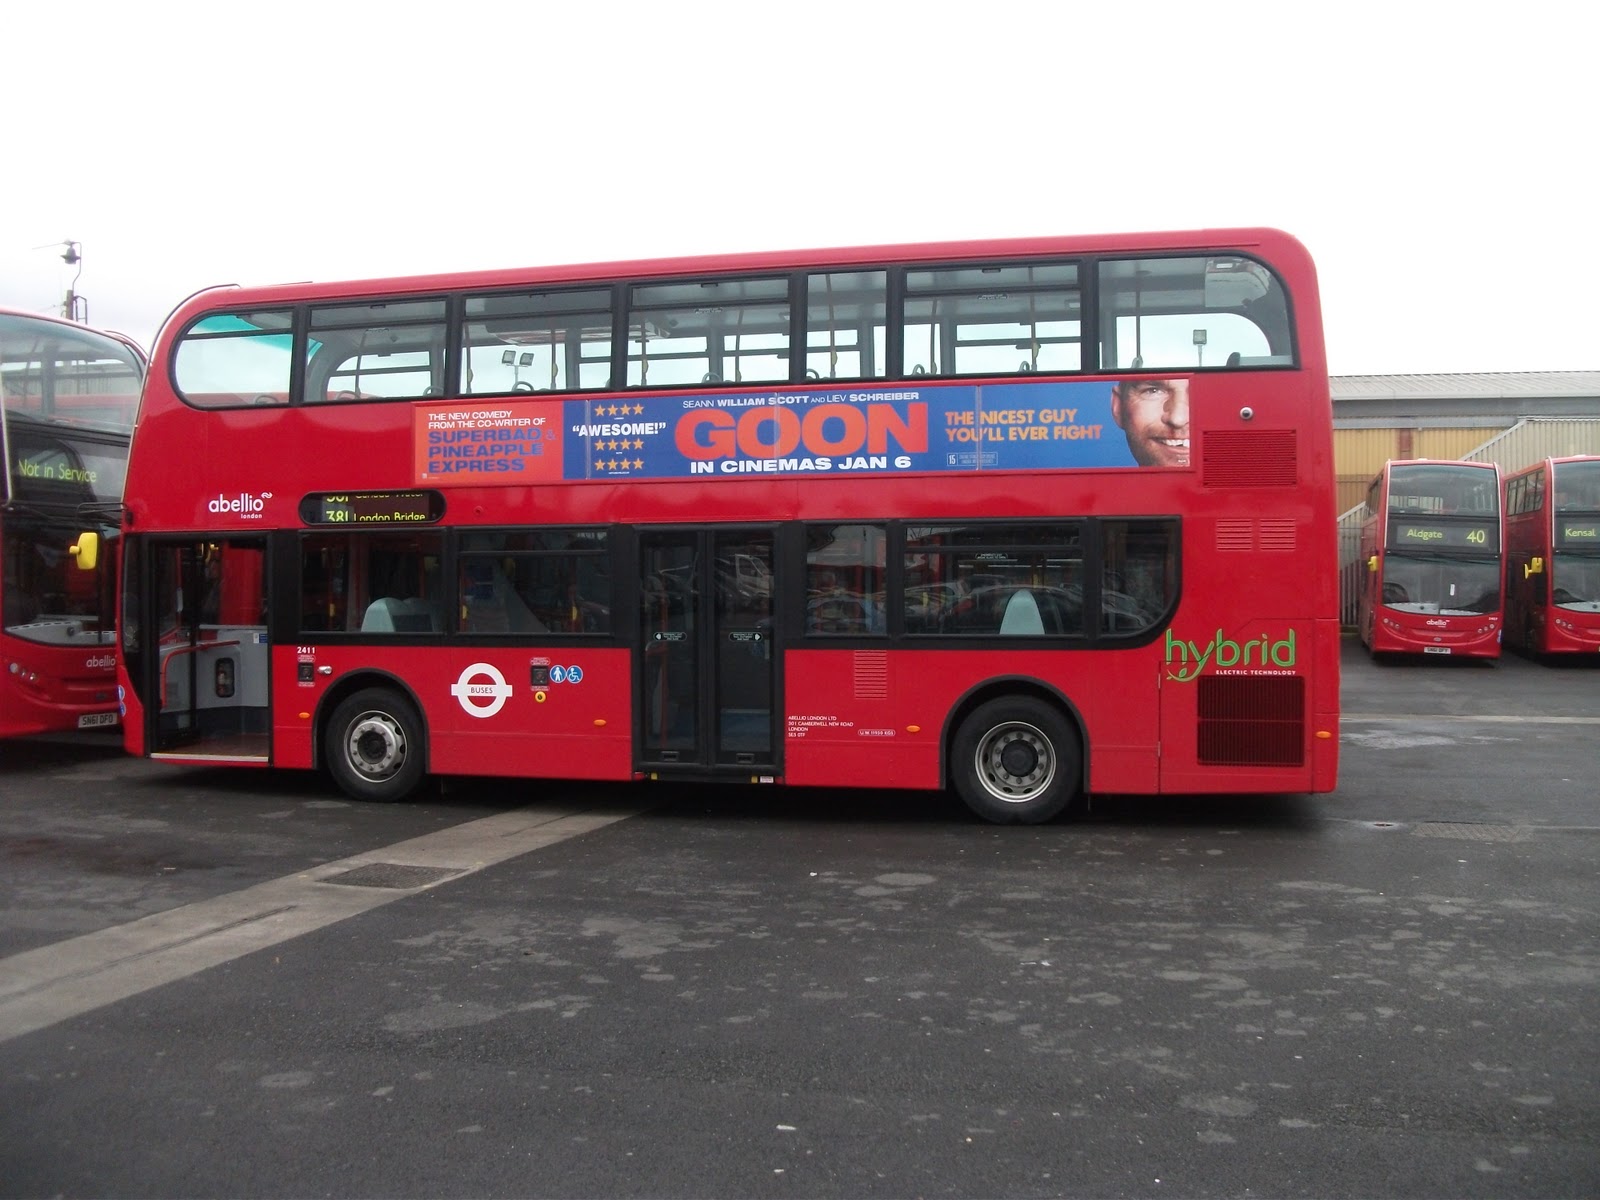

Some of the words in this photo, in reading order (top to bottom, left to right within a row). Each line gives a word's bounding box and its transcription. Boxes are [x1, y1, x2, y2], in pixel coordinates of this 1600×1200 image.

[682, 400, 715, 408] SEANN
[717, 398, 765, 407] WILLIAM
[768, 396, 810, 405] SCOTT
[826, 394, 847, 402] LIEV
[849, 392, 919, 402] SCHREIBER
[428, 413, 447, 421] THE
[448, 412, 470, 420] NEW
[472, 410, 512, 419] COMEDY
[428, 421, 455, 429] FROM
[457, 420, 475, 428] THE
[477, 418, 531, 427] CO-WRITER
[532, 417, 546, 426] OF
[945, 411, 974, 425] THE
[980, 410, 1035, 424] NICEST
[1039, 408, 1078, 423] GUY
[428, 427, 542, 444] SUPERBAD
[674, 402, 928, 460] GOON
[1009, 425, 1049, 440] EVER
[1053, 424, 1103, 440] FIGHT
[428, 442, 544, 458] PINEAPPLE
[428, 458, 525, 473] EXPRESS
[690, 461, 714, 474] IN
[720, 457, 832, 473] CINEMAS
[838, 456, 887, 470] JAN
[894, 456, 912, 468] 6
[949, 454, 956, 465] 15
[18, 458, 40, 477] Not
[44, 463, 54, 478] in
[58, 463, 97, 483] Service
[208, 492, 264, 513] abellio
[1406, 528, 1443, 541] Aldgate
[1466, 530, 1486, 543] 40
[1565, 528, 1596, 537] Kensal
[296, 646, 316, 654] 2411
[1165, 628, 1296, 682] hybrid
[86, 655, 116, 668] abellio
